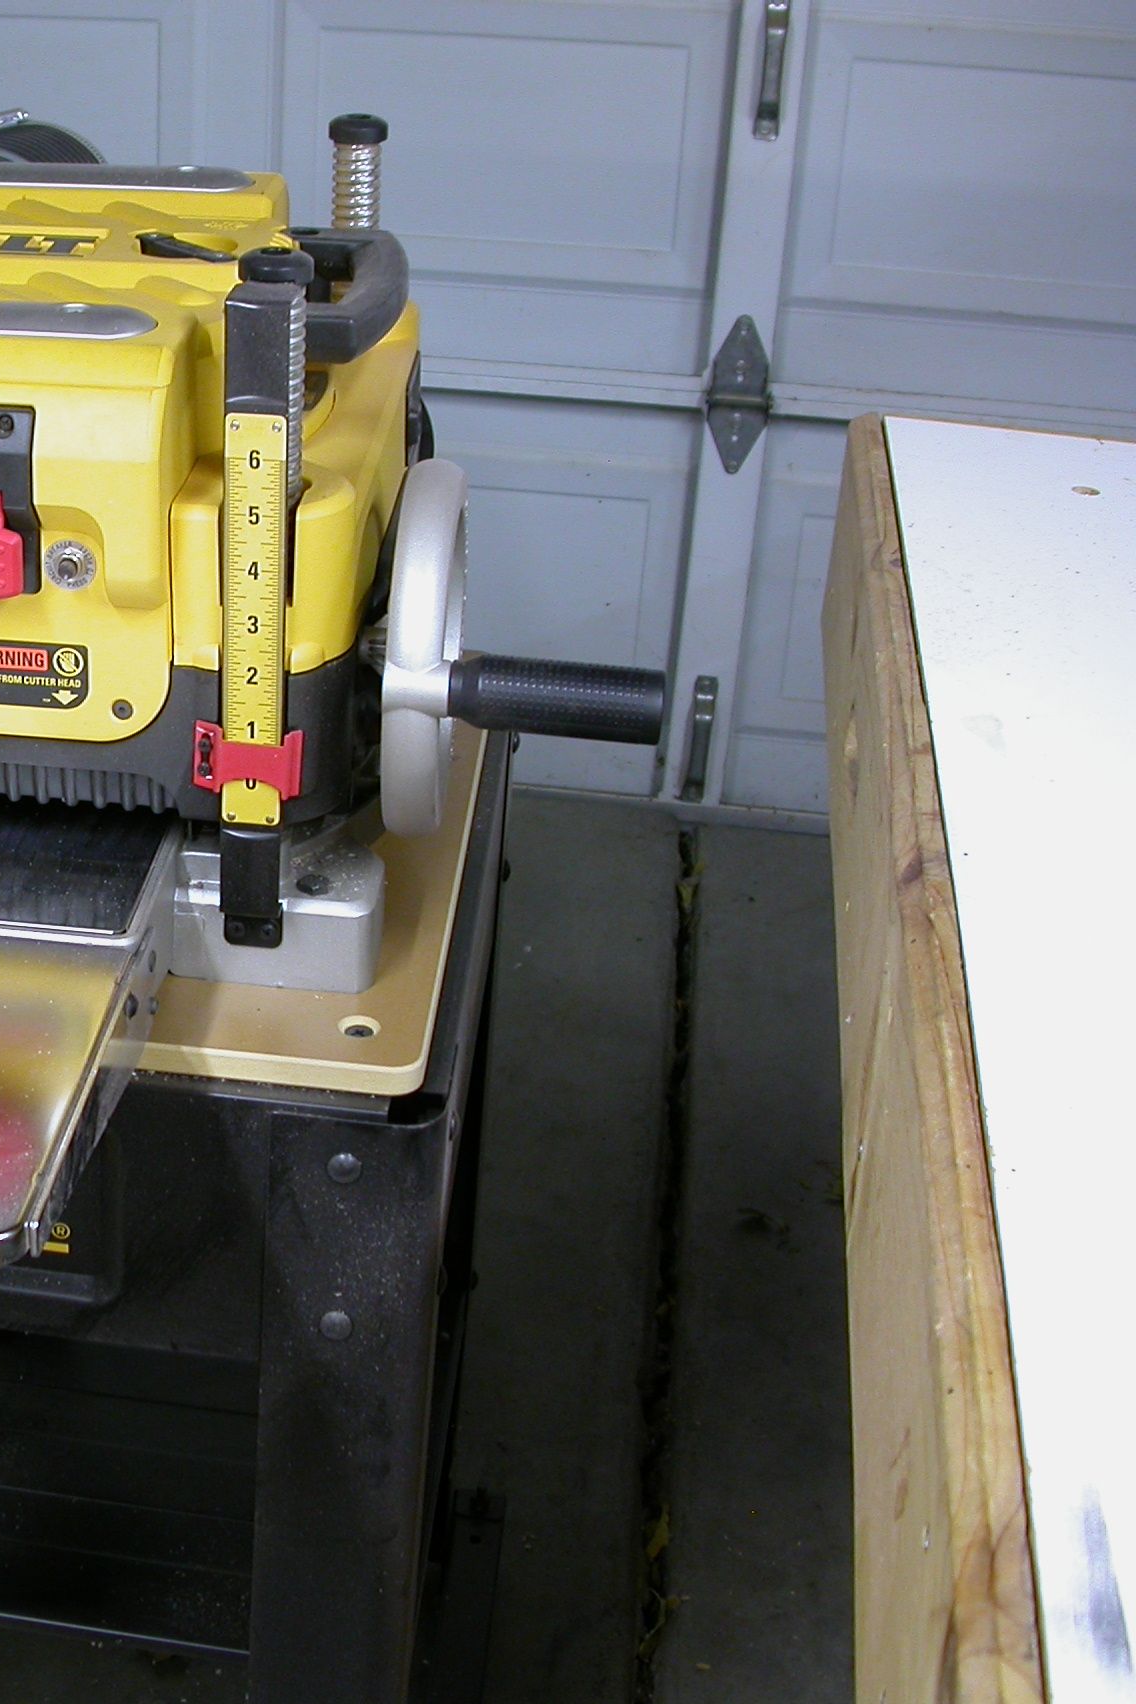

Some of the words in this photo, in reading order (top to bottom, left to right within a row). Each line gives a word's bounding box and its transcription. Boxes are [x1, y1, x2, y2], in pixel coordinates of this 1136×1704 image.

[249, 449, 261, 469] 6
[248, 506, 260, 525] 5
[247, 561, 259, 580] 4
[247, 615, 259, 634] 3
[24, 676, 57, 686] CUTTER
[57, 678, 82, 688] HEAD
[246, 667, 258, 685] 2
[247, 721, 255, 739] 1
